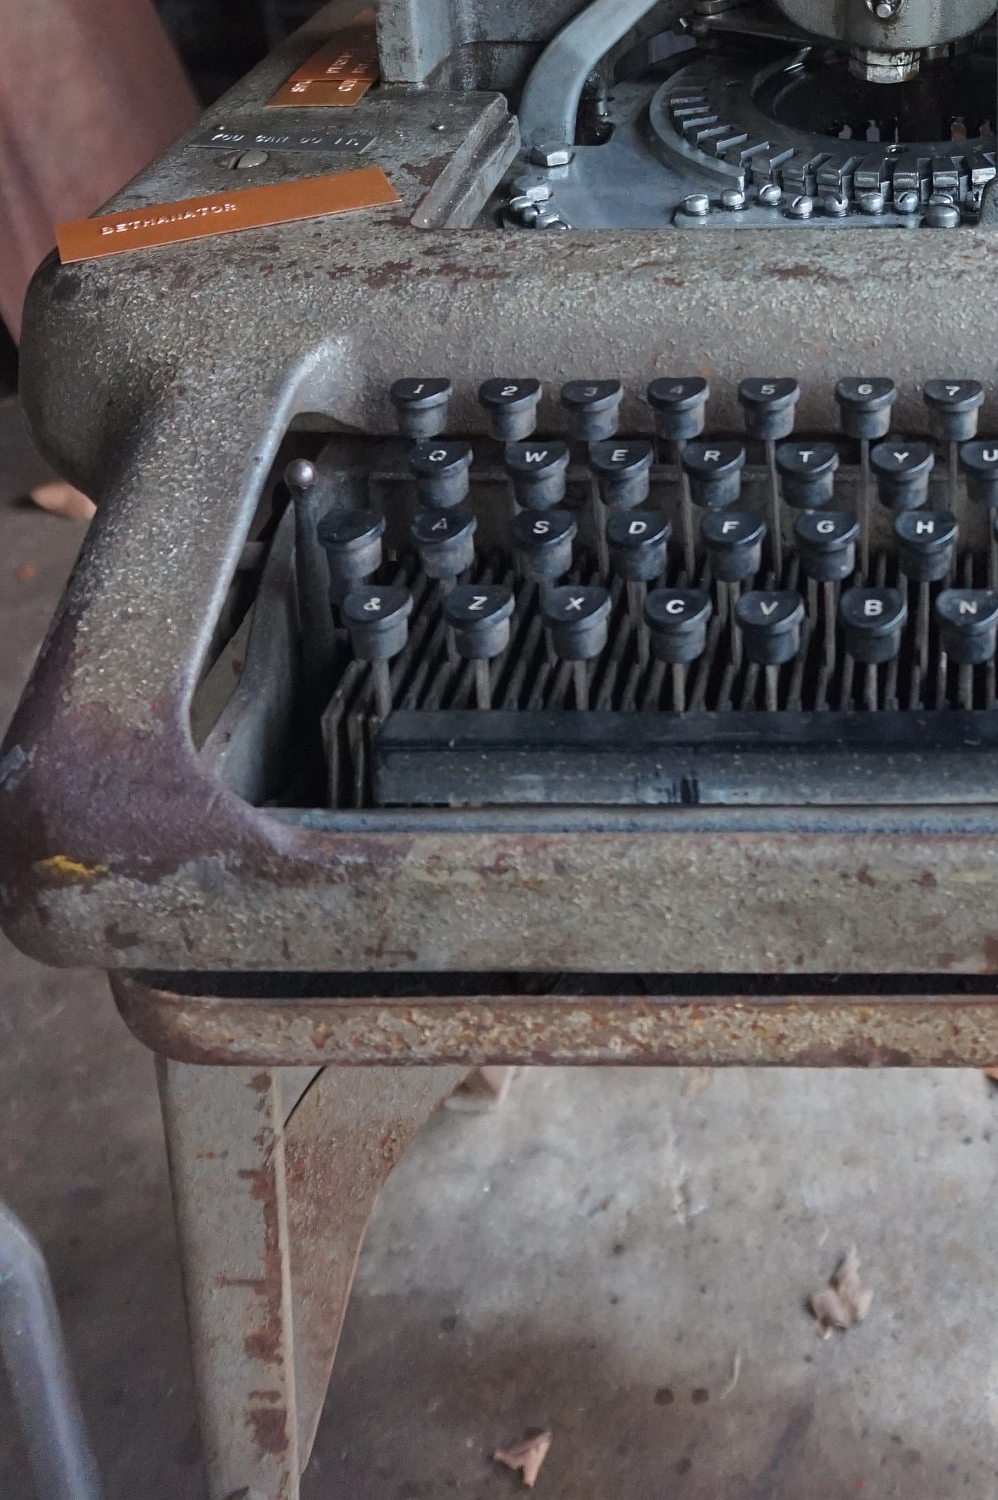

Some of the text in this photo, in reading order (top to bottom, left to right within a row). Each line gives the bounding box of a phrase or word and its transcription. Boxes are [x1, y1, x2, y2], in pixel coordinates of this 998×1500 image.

[101, 202, 237, 236] BETHANATOR
[500, 385, 518, 396] 2
[760, 384, 775, 395] 5
[857, 384, 873, 395] 6
[945, 385, 961, 396] 7
[525, 450, 548, 463] W
[611, 449, 628, 462] E
[703, 450, 721, 462] R
[799, 450, 814, 463] T
[893, 451, 909, 463] Y
[431, 517, 448, 531] A
[533, 520, 550, 534] S
[628, 521, 647, 535] D
[722, 520, 739, 534] F
[816, 519, 835, 534] G
[916, 520, 934, 534] H
[363, 597, 381, 611] &
[468, 595, 488, 611] Z
[565, 597, 585, 610] X
[665, 599, 685, 614] C
[759, 601, 779, 616] V
[864, 599, 883, 616] B
[959, 600, 977, 614] N
